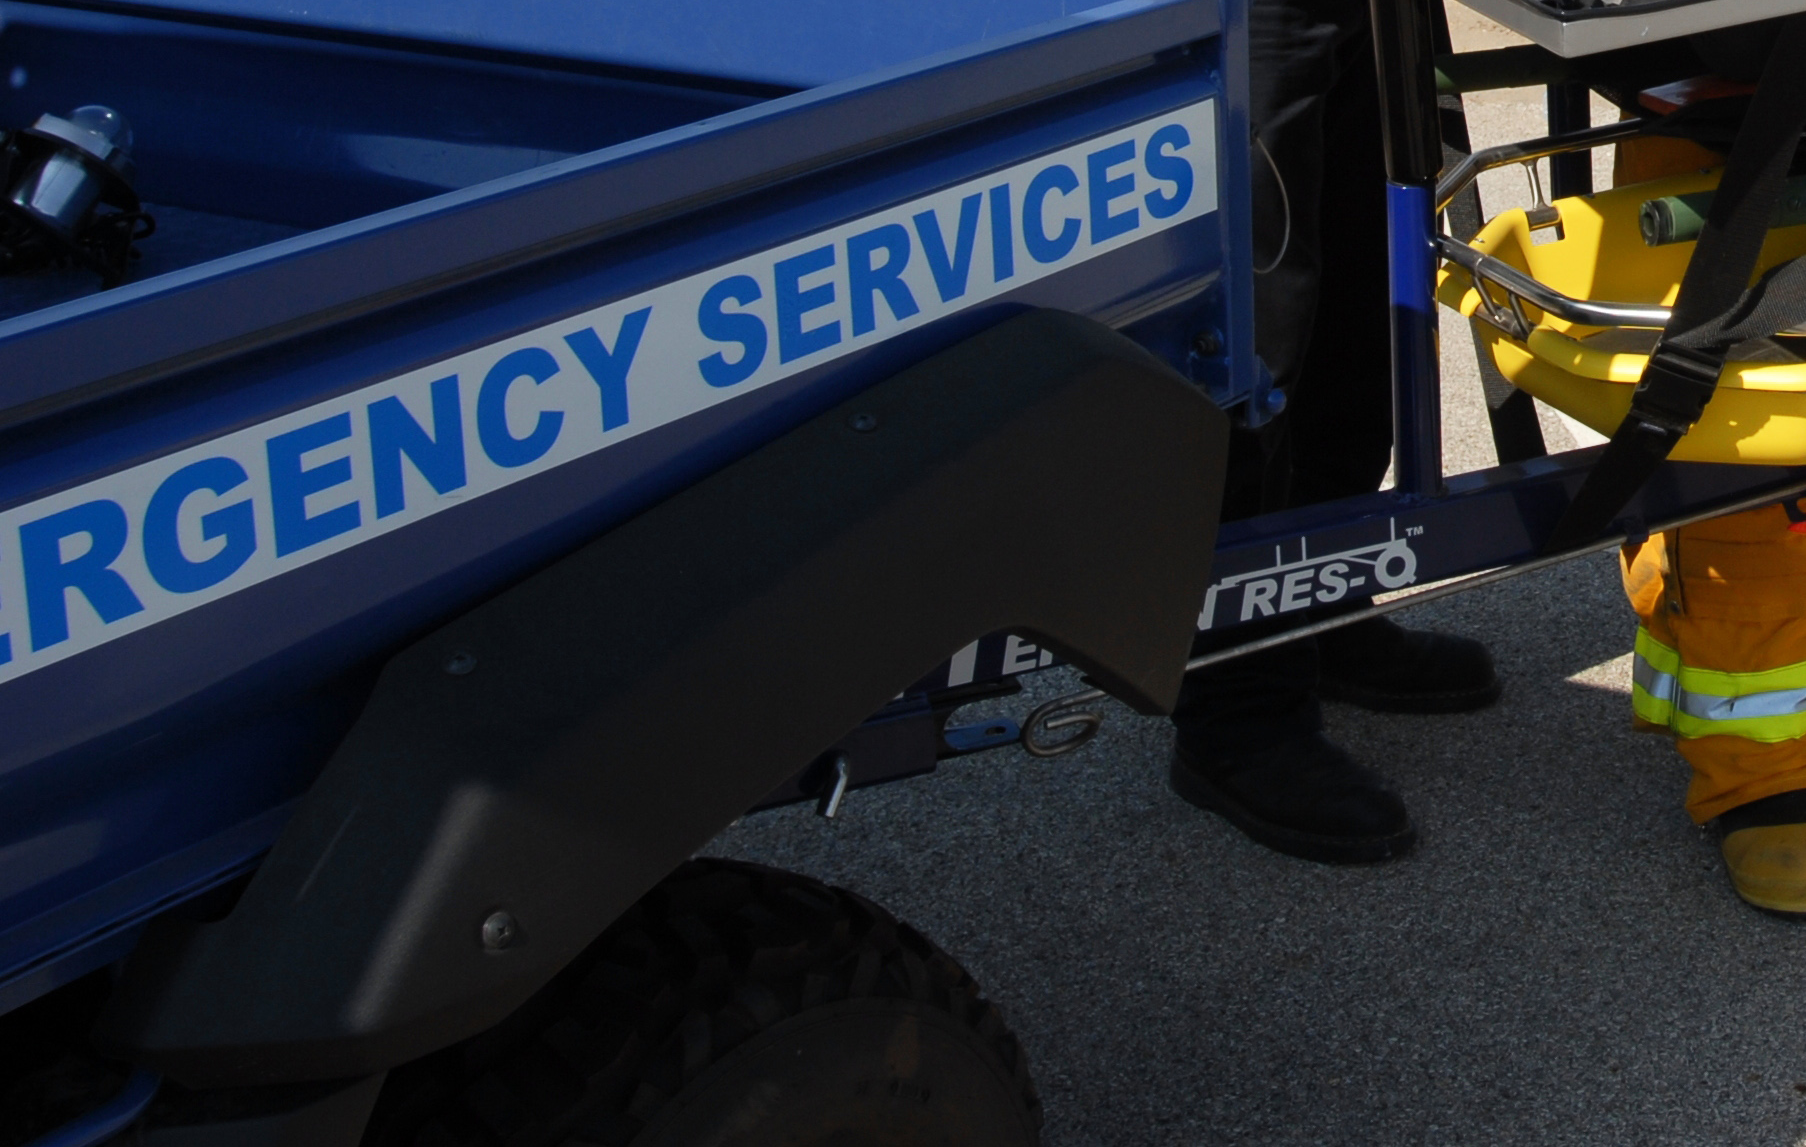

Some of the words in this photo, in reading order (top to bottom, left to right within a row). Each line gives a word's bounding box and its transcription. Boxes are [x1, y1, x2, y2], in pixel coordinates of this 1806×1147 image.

[0, 307, 652, 666] RGENCY
[698, 123, 1194, 388] SERVICES
[1405, 526, 1424, 537] TM
